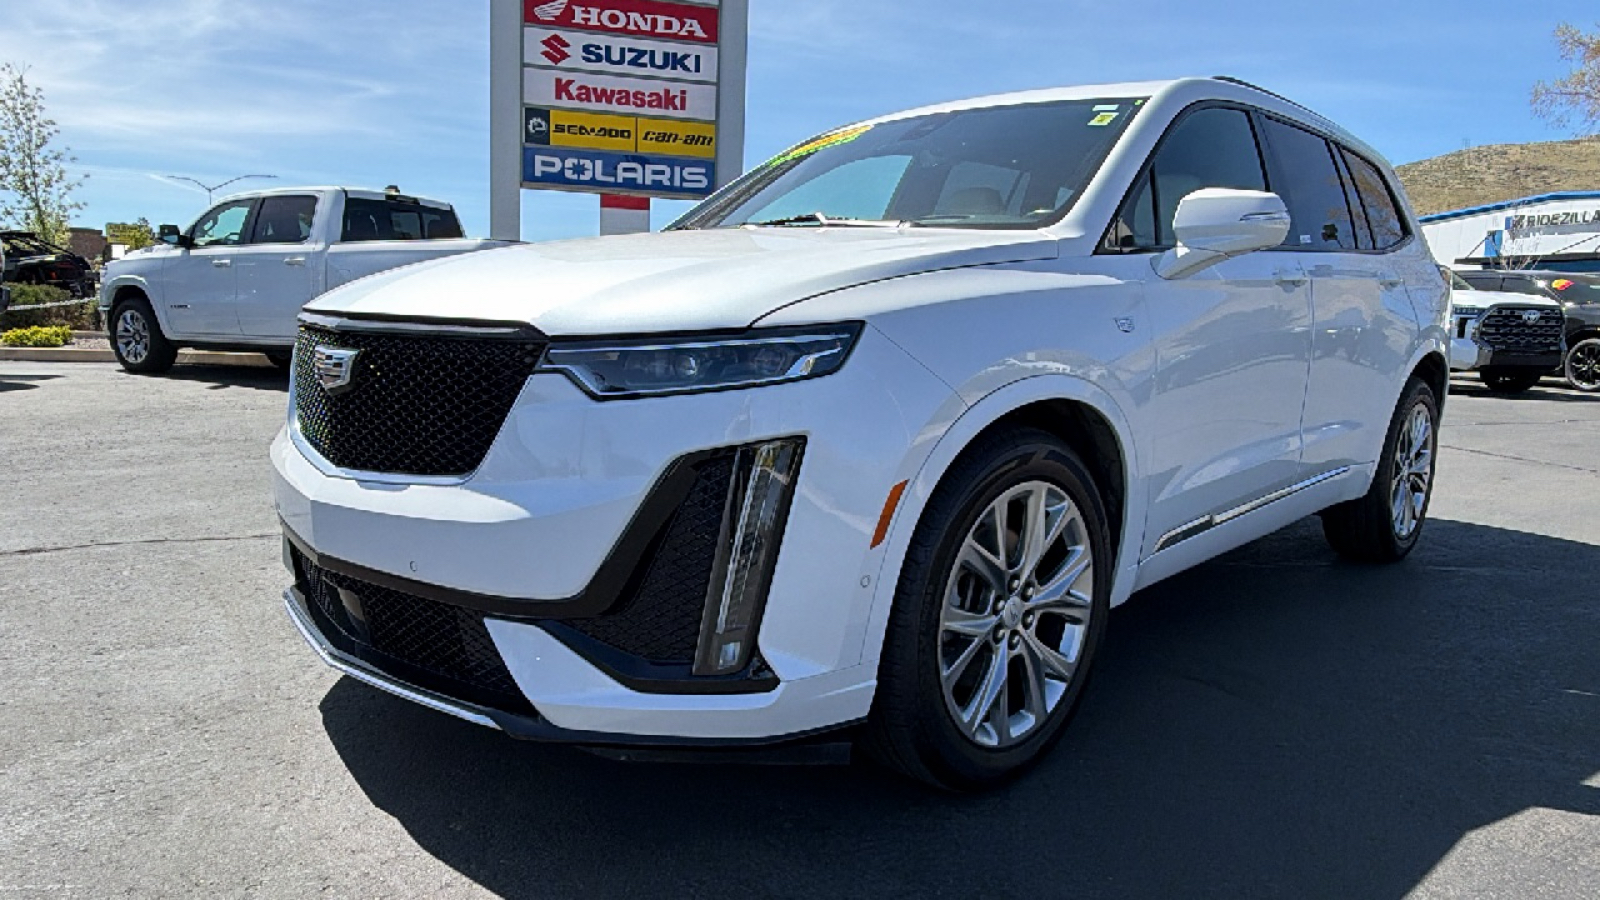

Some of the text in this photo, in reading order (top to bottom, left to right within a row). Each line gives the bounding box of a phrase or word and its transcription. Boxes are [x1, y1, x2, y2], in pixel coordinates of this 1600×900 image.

[571, 5, 707, 38] HONDA
[581, 43, 701, 73] SUZUKI
[554, 77, 687, 111] Kawasaki
[534, 154, 708, 189] POLARIS
